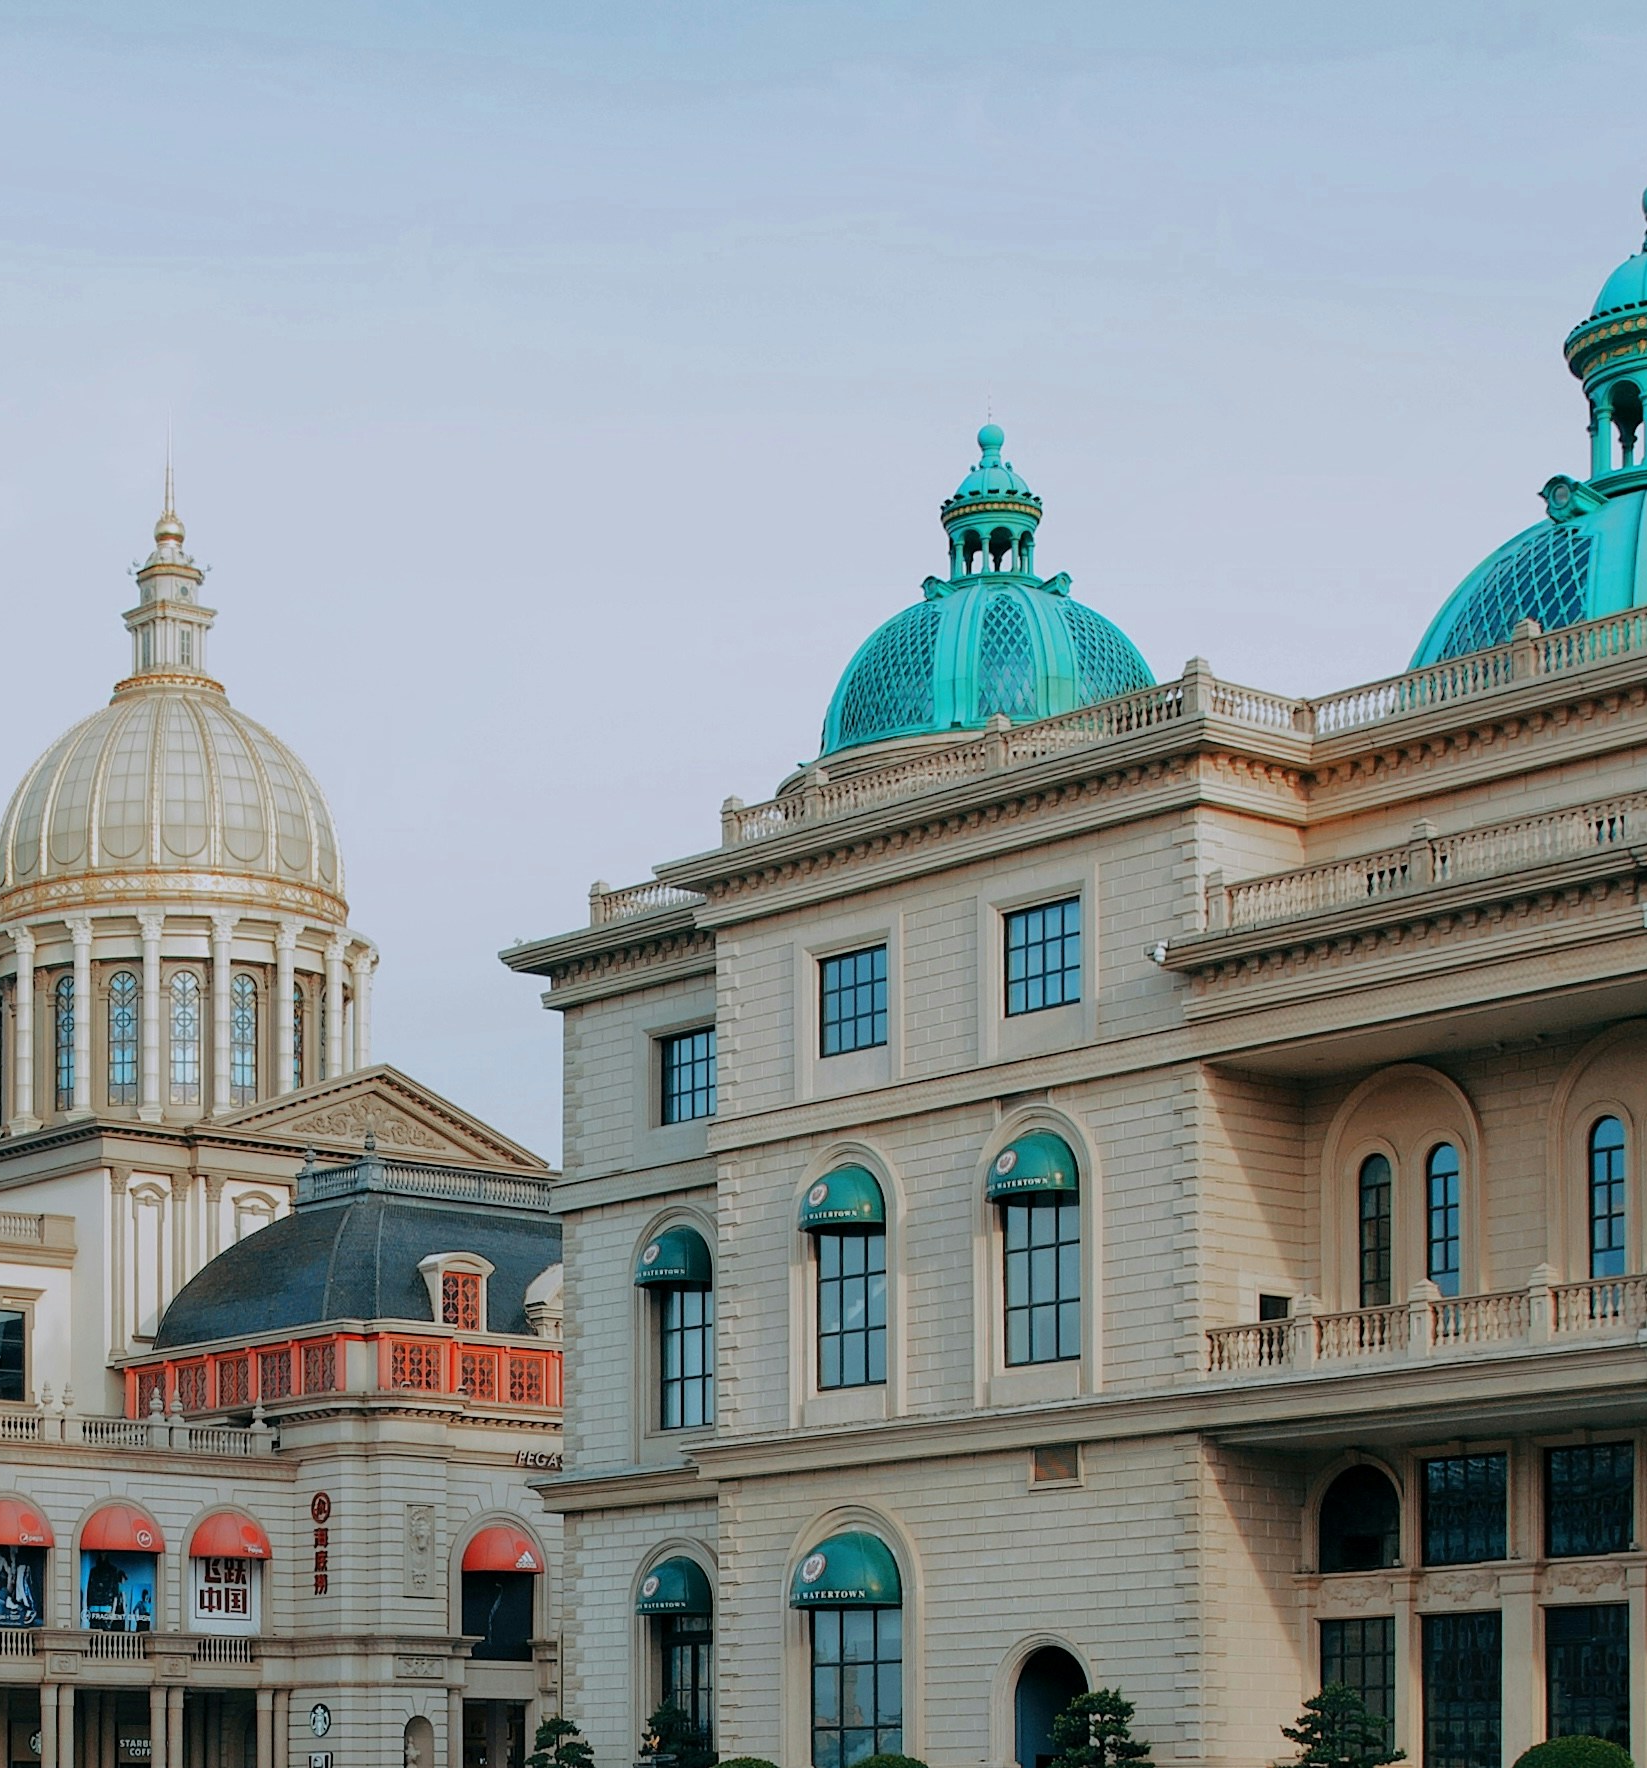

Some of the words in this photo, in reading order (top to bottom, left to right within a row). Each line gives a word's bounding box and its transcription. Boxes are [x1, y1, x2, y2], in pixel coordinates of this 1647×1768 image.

[997, 1177, 1048, 1188] WATERTOWN
[809, 1210, 857, 1219] WATERTOWN
[515, 1562, 538, 1570] adidas
[802, 1590, 866, 1600] WATERTOWN
[199, 1587, 247, 1614] 中国
